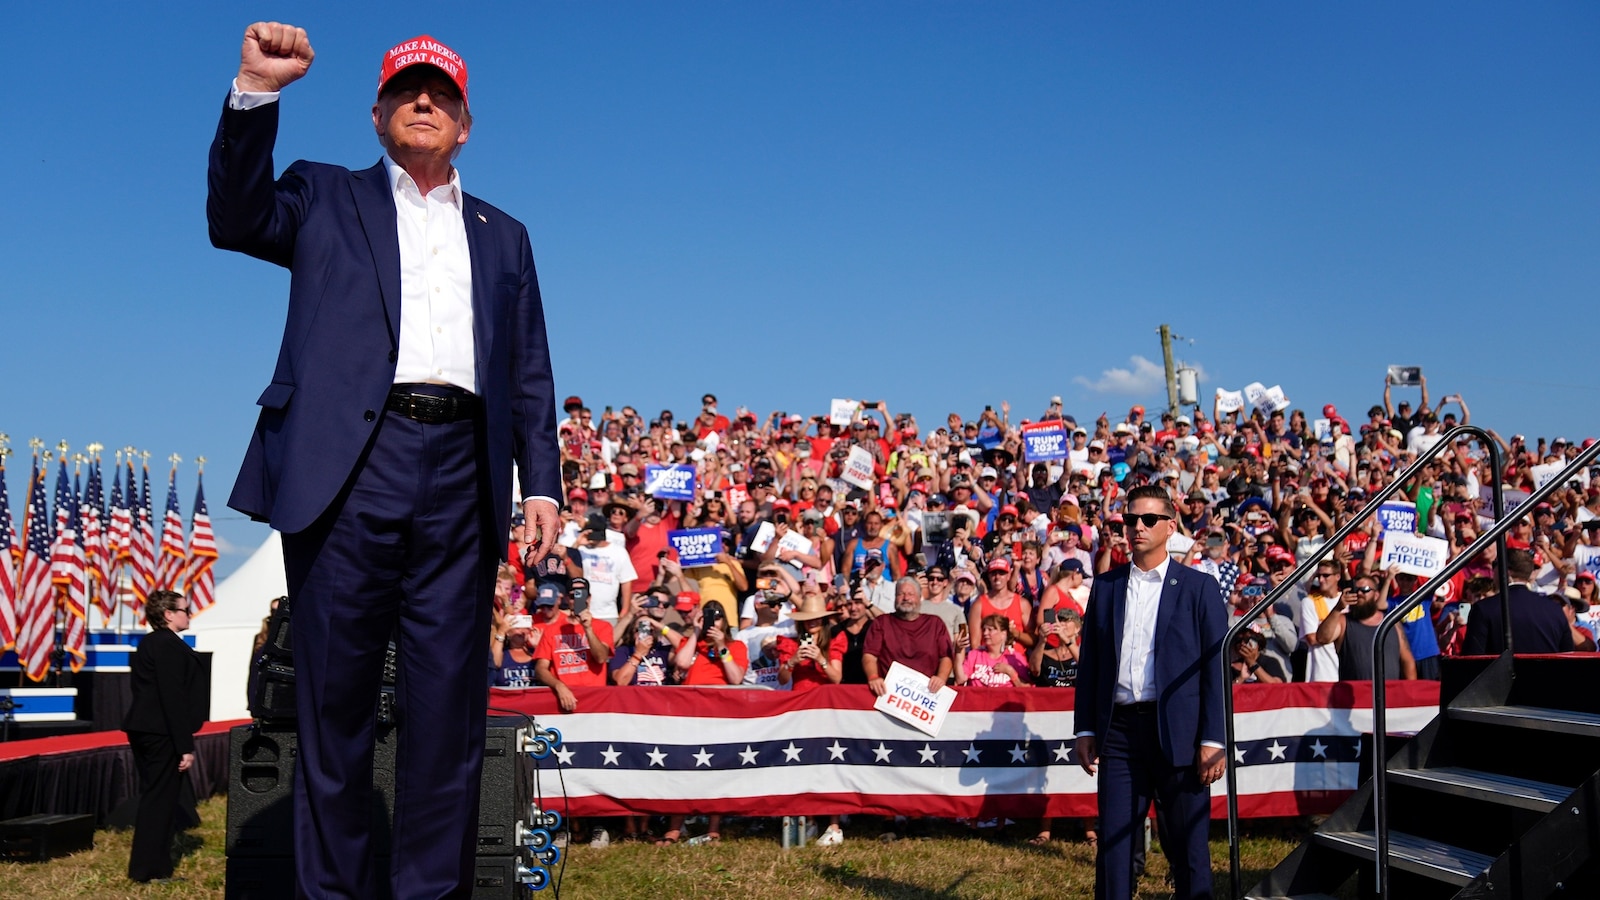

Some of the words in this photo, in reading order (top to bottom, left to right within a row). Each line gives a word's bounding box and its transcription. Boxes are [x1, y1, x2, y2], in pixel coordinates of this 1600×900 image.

[389, 41, 419, 59] MAKE
[420, 40, 464, 69] AMERICA
[395, 52, 427, 69] GREAT
[429, 55, 458, 78] AGAIN
[1027, 435, 1064, 446] TRUMP
[1033, 443, 1060, 453] 2024
[659, 478, 686, 489] 024
[1381, 509, 1415, 522] TRUMP
[1387, 520, 1412, 530] 2024
[672, 533, 717, 547] TRUMP
[679, 544, 712, 556] 2024
[1394, 544, 1437, 558] YOU'RE
[536, 558, 566, 577] USA
[1387, 553, 1439, 570] FIRED!
[560, 651, 586, 665] 2024
[755, 667, 780, 676] TRUM
[760, 674, 777, 683] 202
[895, 683, 938, 712] YOU'RE
[887, 694, 935, 725] FIRED!
